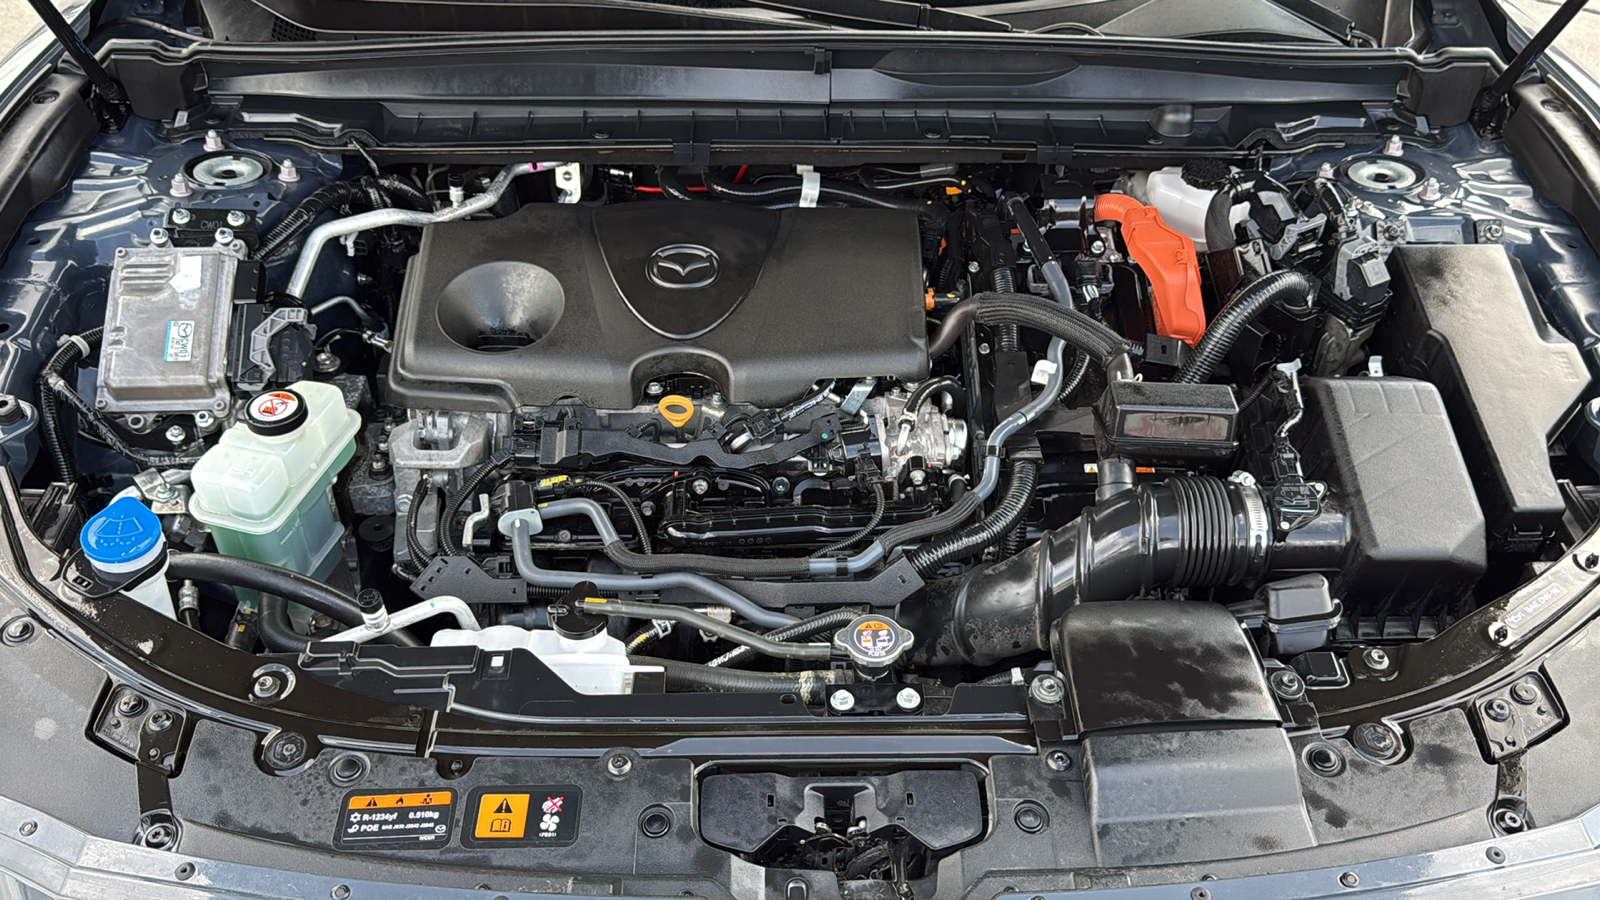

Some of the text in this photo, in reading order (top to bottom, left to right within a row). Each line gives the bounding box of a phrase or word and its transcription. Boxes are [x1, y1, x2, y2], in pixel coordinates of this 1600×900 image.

[200, 220, 223, 229] CW01
[180, 338, 189, 357] CW01
[362, 811, 440, 821] R-1234yf 0.510kg
[360, 824, 379, 832] POE
